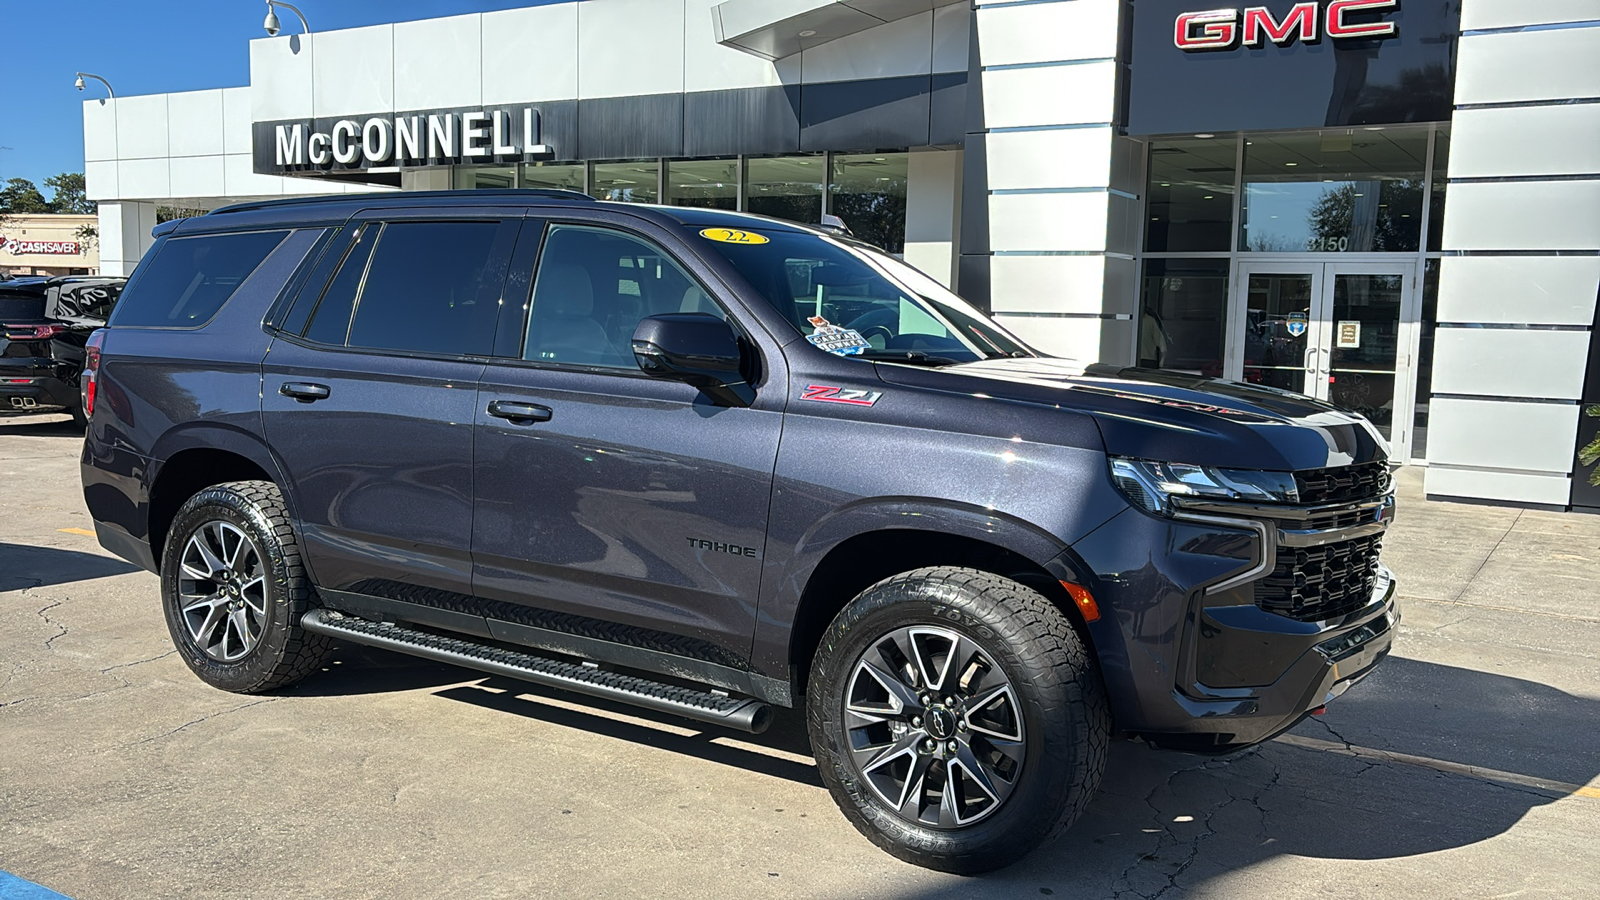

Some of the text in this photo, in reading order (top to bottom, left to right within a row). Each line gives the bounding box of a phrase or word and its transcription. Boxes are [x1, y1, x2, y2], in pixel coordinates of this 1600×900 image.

[1173, 0, 1397, 50] GMC
[275, 107, 548, 166] McCONNELL
[721, 229, 750, 243] 22
[1306, 236, 1349, 252] 3150
[799, 384, 883, 407] Z71
[685, 536, 757, 559] TAHOE
[931, 604, 996, 640] TOYO
